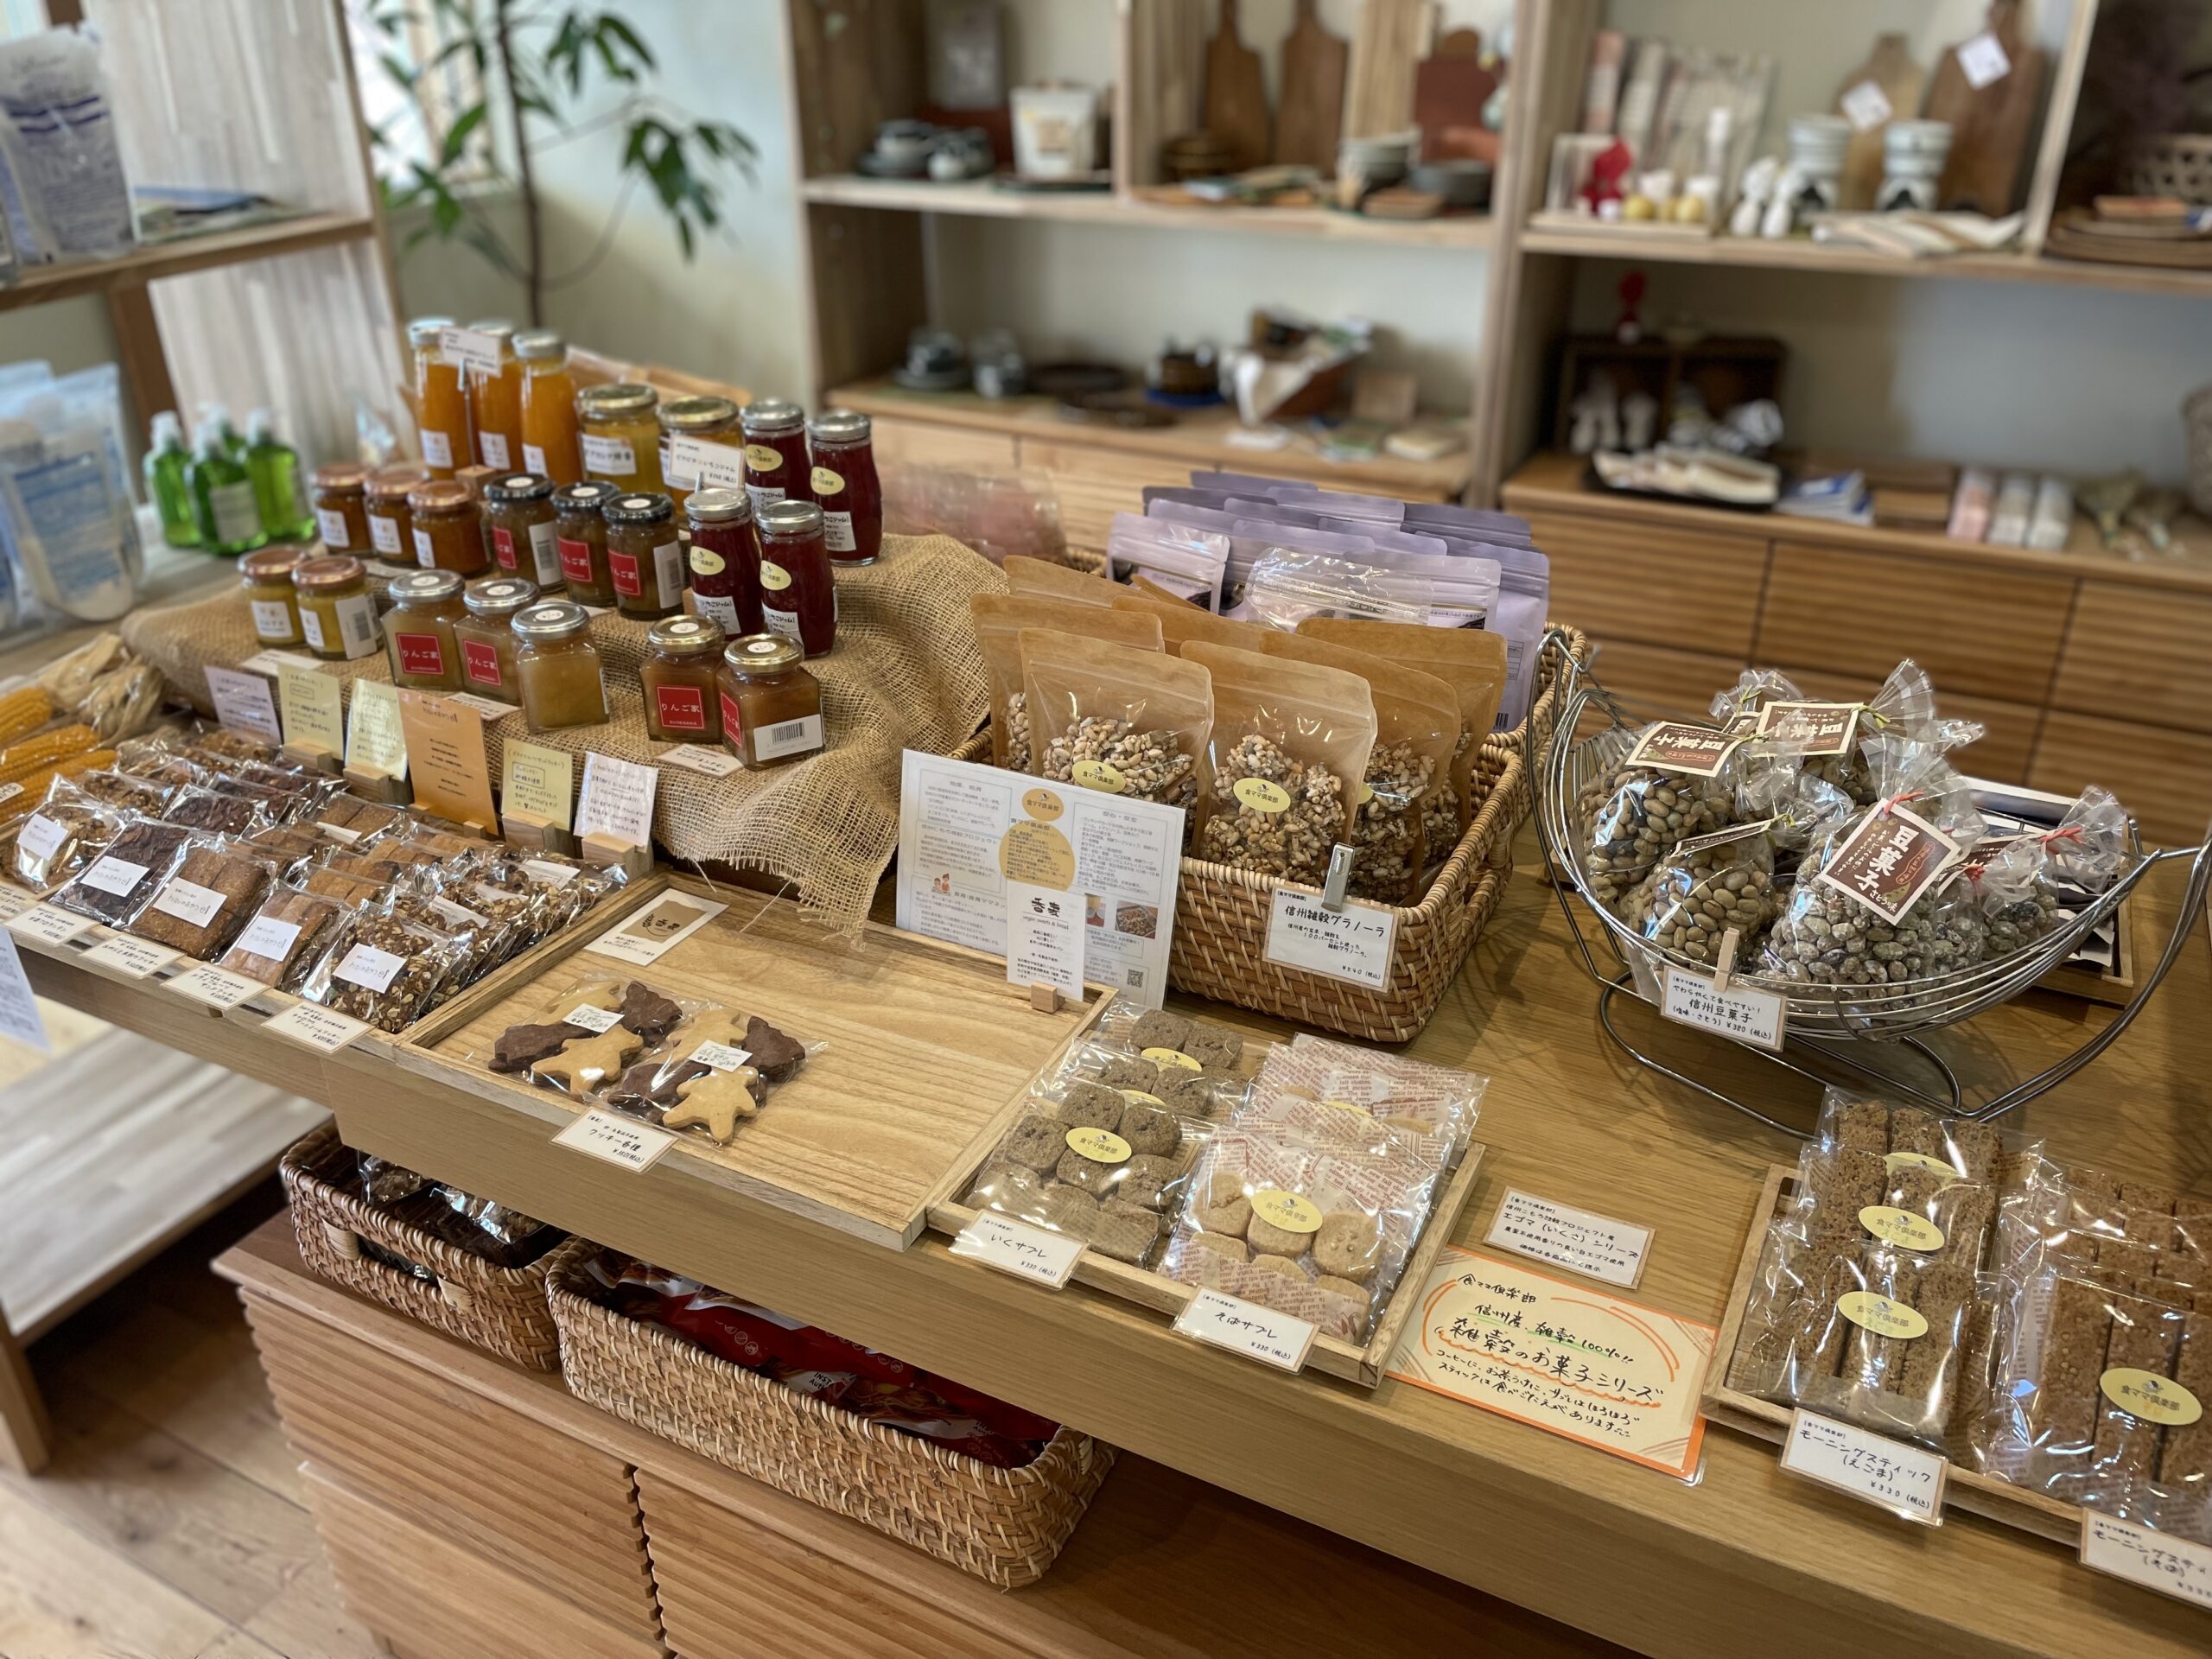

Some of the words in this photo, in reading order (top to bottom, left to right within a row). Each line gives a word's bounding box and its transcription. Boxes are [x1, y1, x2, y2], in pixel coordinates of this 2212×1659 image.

[661, 702, 701, 713] りんご家
[1082, 770, 1114, 785] 食ママ倶楽部
[1027, 798, 1059, 812] 食ママ倶楽部
[1244, 787, 1279, 804] 食ママ倶楽部
[1854, 824, 1919, 891] 豆菓子
[1031, 897, 1061, 918] 香麦
[1285, 905, 1385, 938] 信州雑穀グラノーラ
[1689, 998, 1752, 1023] 信州豆菓子
[1079, 1136, 1118, 1154] 食ママ倶楽部
[1265, 1202, 1308, 1223] 食ママ倶楽部
[1876, 1218, 1927, 1240] 食ママ倶楽部
[991, 1234, 1047, 1258] いくサブレ
[1458, 1273, 1536, 1304] 食ママ倶楽部
[1215, 1312, 1278, 1338] そばサブレ
[1856, 1305, 1910, 1327] 食ママ倶楽部
[1450, 1317, 1664, 1402] 雑穀のお菓子シリーズ
[2120, 1384, 2181, 1411] 食ママ倶楽部
[1800, 1429, 1931, 1483] モーニングスティック
[1843, 1454, 1894, 1482] (えごま)
[1870, 1480, 1901, 1497] ¥330
[1906, 1494, 1930, 1509] (税込)
